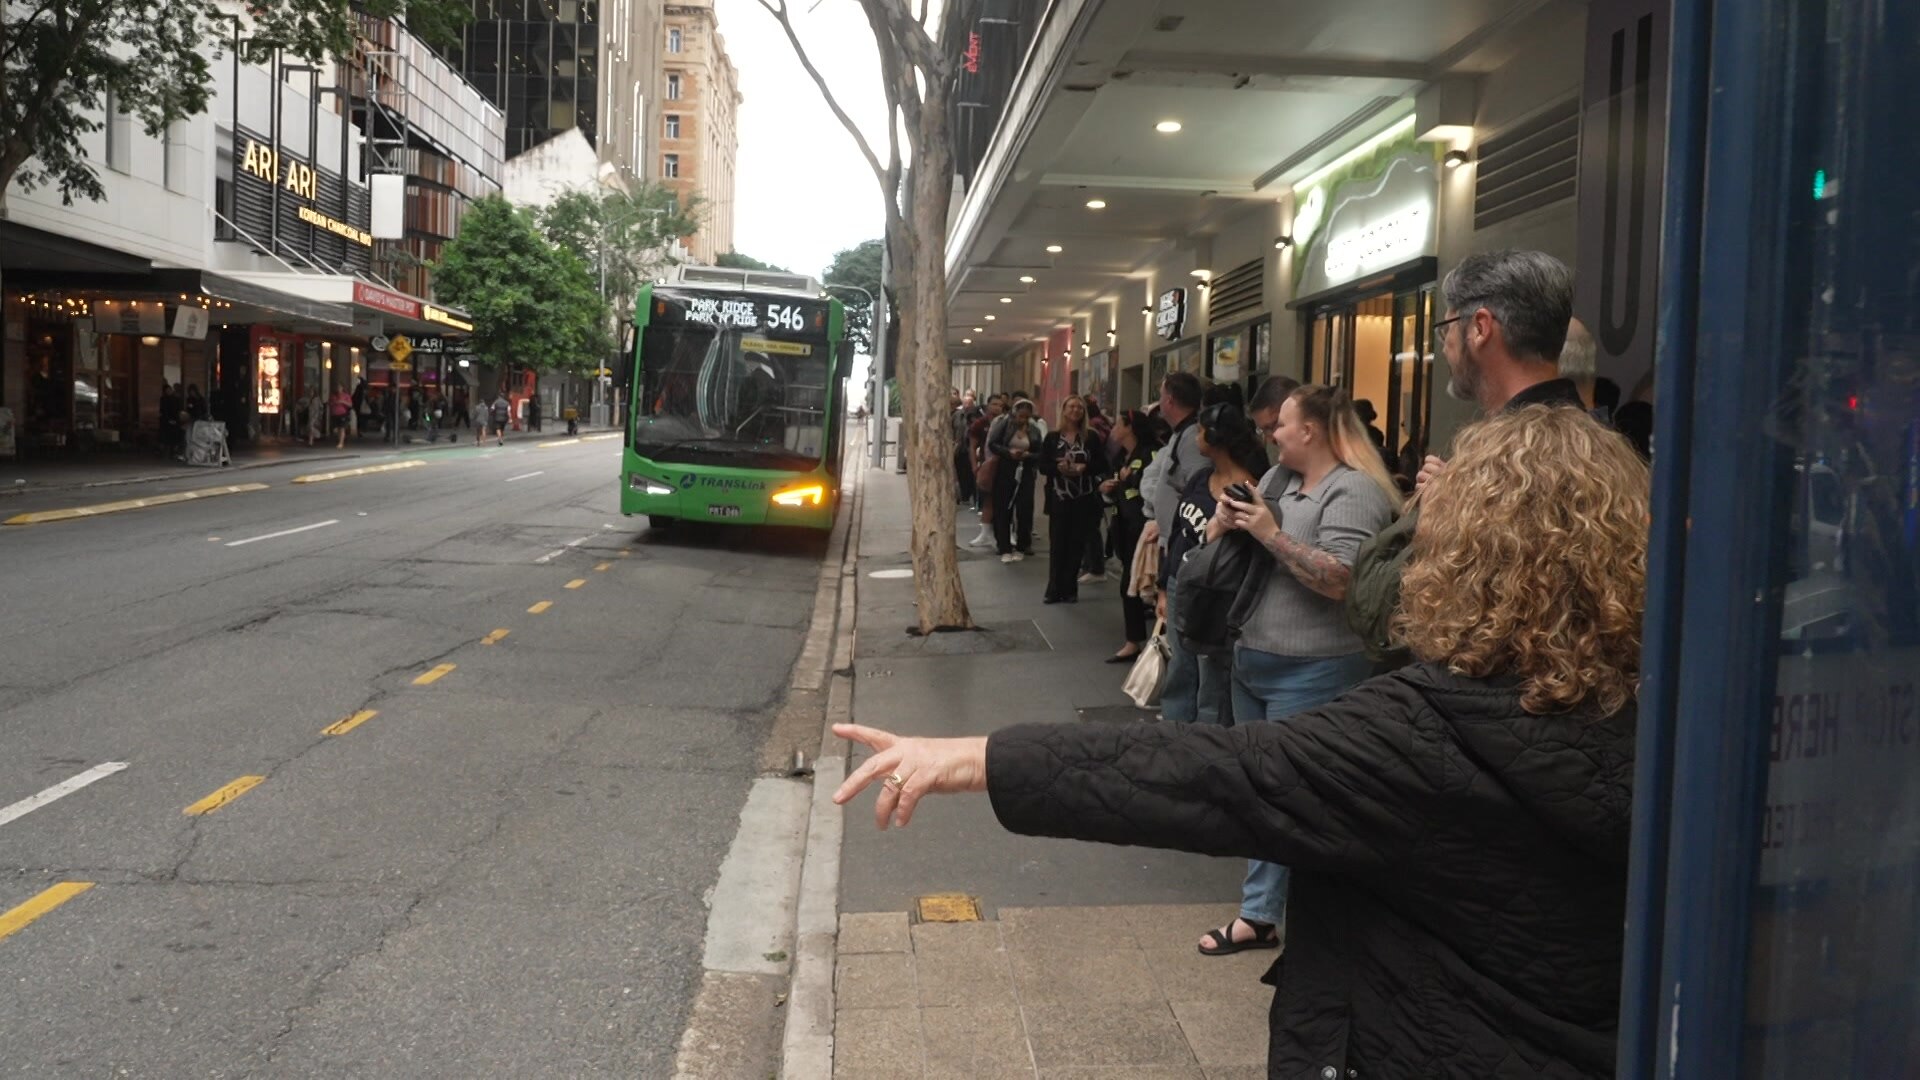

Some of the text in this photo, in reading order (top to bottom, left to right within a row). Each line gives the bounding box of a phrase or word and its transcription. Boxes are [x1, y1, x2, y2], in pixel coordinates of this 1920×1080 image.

[243, 140, 316, 200] ARI ARI
[691, 298, 754, 316] PARK RIDGE
[767, 304, 804, 331] 546
[685, 310, 713, 324] PARK
[732, 314, 757, 327] RIDE
